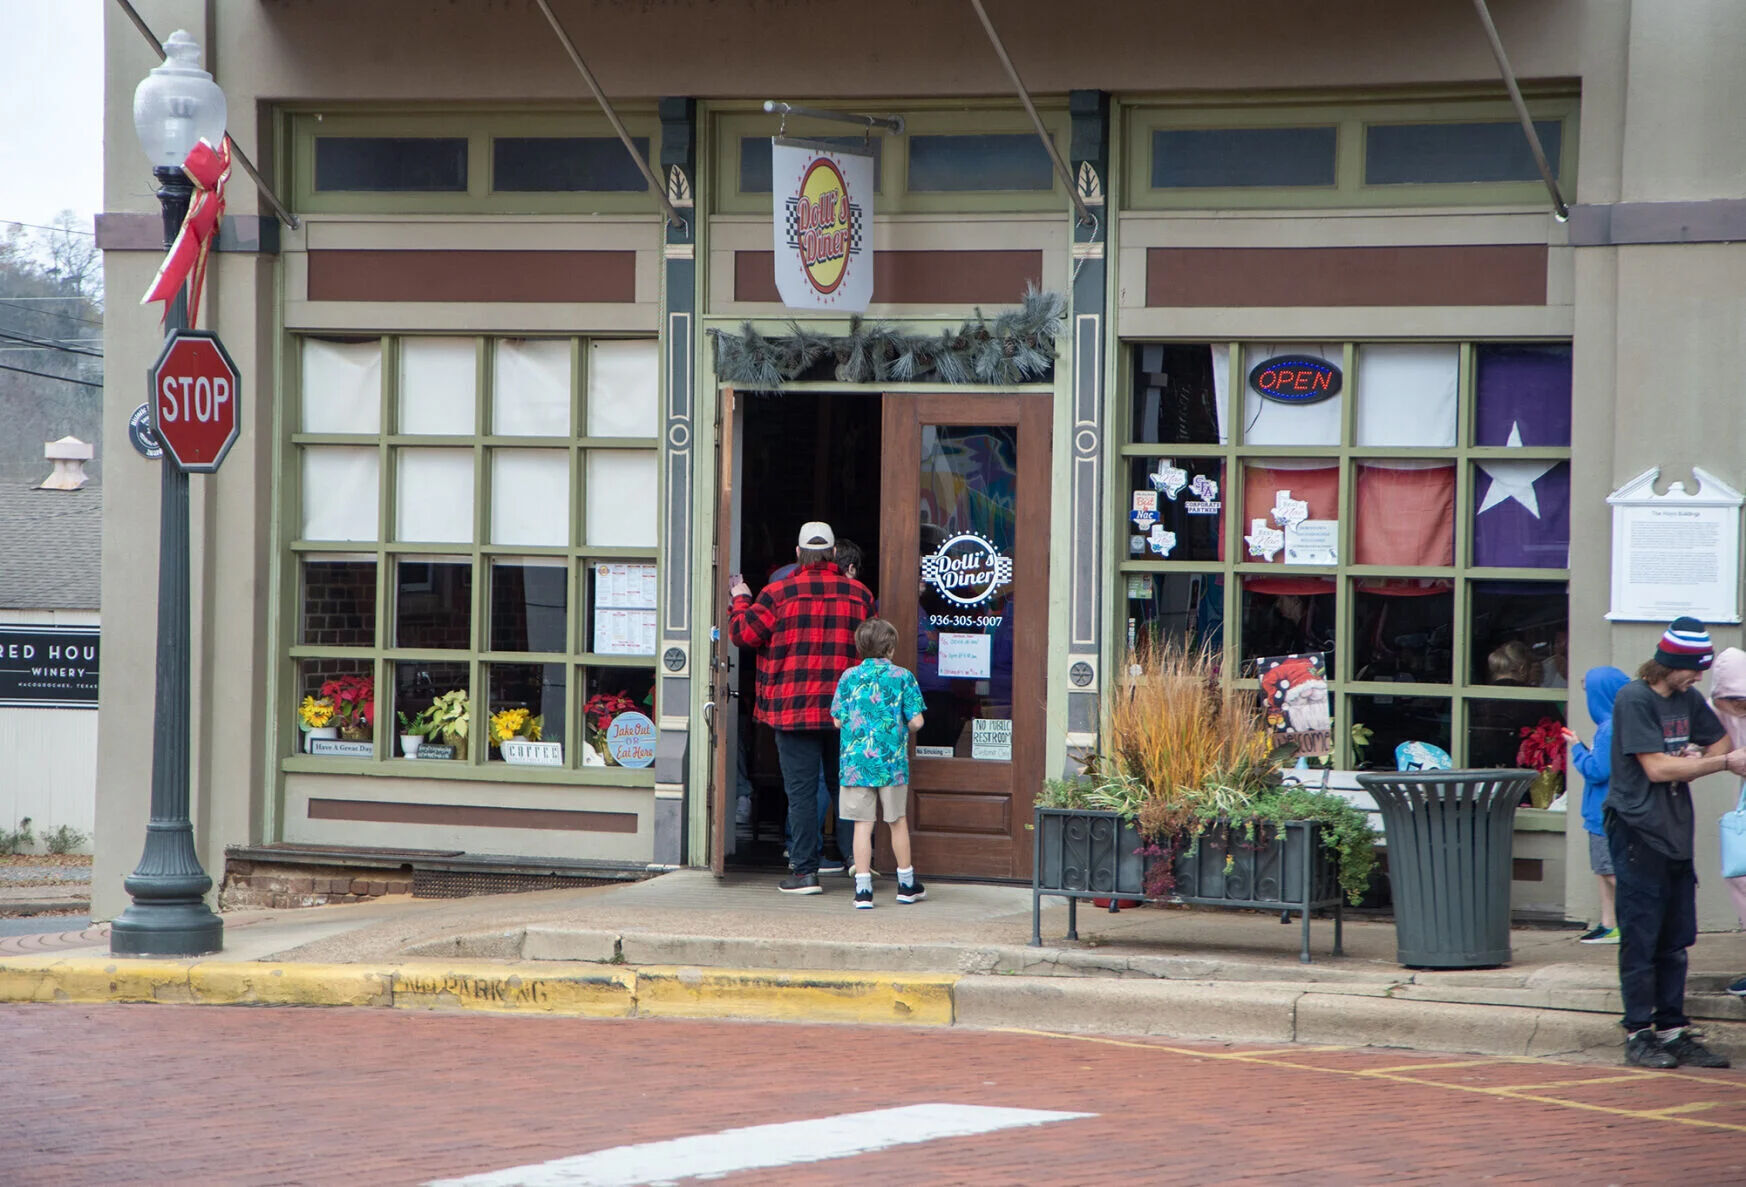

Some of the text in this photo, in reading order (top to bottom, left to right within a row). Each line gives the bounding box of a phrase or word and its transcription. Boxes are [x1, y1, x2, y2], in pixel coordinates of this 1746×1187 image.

[796, 187, 847, 233] Dolli's
[803, 228, 848, 266] Diner
[1259, 370, 1333, 390] OPEN
[162, 375, 229, 422] STOP
[1195, 477, 1213, 497] SFA
[1137, 510, 1154, 519] Nac
[936, 551, 994, 572] Dolli's
[943, 570, 994, 588] Diner
[930, 614, 1002, 627] 936-305-5007
[31, 667, 85, 677] WINERY
[613, 723, 650, 738] Take Out
[976, 719, 1010, 731] NO PUBLIC
[360, 745, 372, 753] Day
[510, 745, 558, 759] COFFEE
[617, 744, 653, 760] Eat Here
[443, 977, 547, 1001] PARKNG
